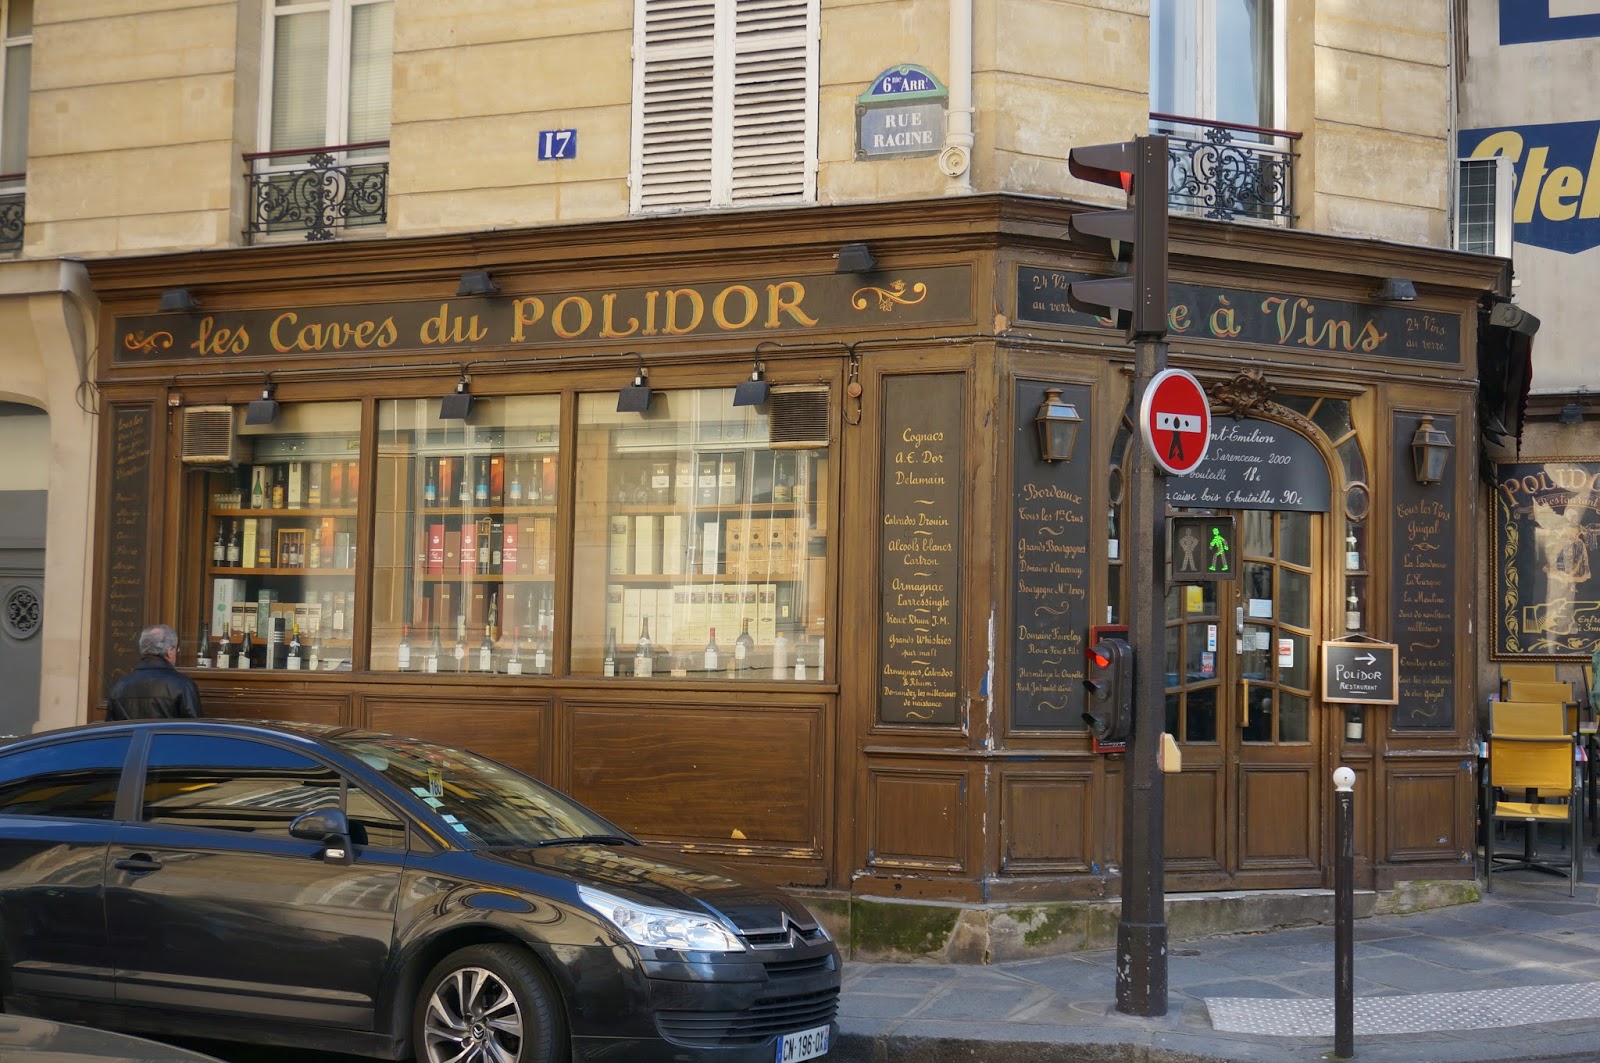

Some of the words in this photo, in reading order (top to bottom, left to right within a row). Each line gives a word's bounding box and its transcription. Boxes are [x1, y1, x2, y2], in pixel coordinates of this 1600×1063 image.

[885, 112, 922, 128] RUE
[544, 131, 572, 158] 17
[873, 130, 933, 148] RACINE
[1033, 275, 1048, 290] 24
[1051, 273, 1069, 290] Vi
[1032, 301, 1045, 310] au
[190, 316, 249, 356] les
[270, 312, 398, 353] Caves
[420, 302, 488, 345] du
[511, 281, 819, 342] POLIDOR
[1210, 295, 1241, 338] à
[1262, 296, 1388, 352] Vins
[1406, 317, 1419, 331] 24
[1422, 315, 1446, 336] Vins
[902, 427, 944, 448] Cognacs
[1209, 425, 1275, 443] nt-Emilion
[921, 450, 944, 463] Dor
[1268, 453, 1292, 465] 2000
[895, 470, 945, 485] Delamain
[1023, 483, 1082, 505] Bordeaux
[1201, 487, 1221, 501] bois
[1537, 493, 1598, 507] Restaurant
[884, 514, 916, 526] Calvados
[918, 512, 950, 526] Drouin
[1019, 506, 1040, 520] Tous
[1041, 507, 1052, 521] les
[1065, 510, 1084, 523] Crus
[1408, 519, 1440, 541] Guigal
[888, 537, 919, 552] Alcools
[922, 537, 952, 552] blancs
[1018, 538, 1046, 559] Grands
[1045, 539, 1086, 559] Bourgognes
[904, 553, 939, 566] Cartron
[1020, 559, 1049, 572] Domaine
[1403, 553, 1413, 568] La
[892, 578, 944, 597] Armagnac
[1018, 579, 1054, 599] Bourgogne
[897, 593, 950, 612] Larressingle
[886, 612, 907, 624] Vieux
[908, 614, 929, 625] Rhum
[1019, 625, 1051, 640] Domaine
[889, 634, 914, 649] Grands
[916, 634, 952, 645] Whiskies
[924, 667, 953, 677] Calvados
[903, 698, 910, 706] de
[912, 699, 943, 708] naissance
